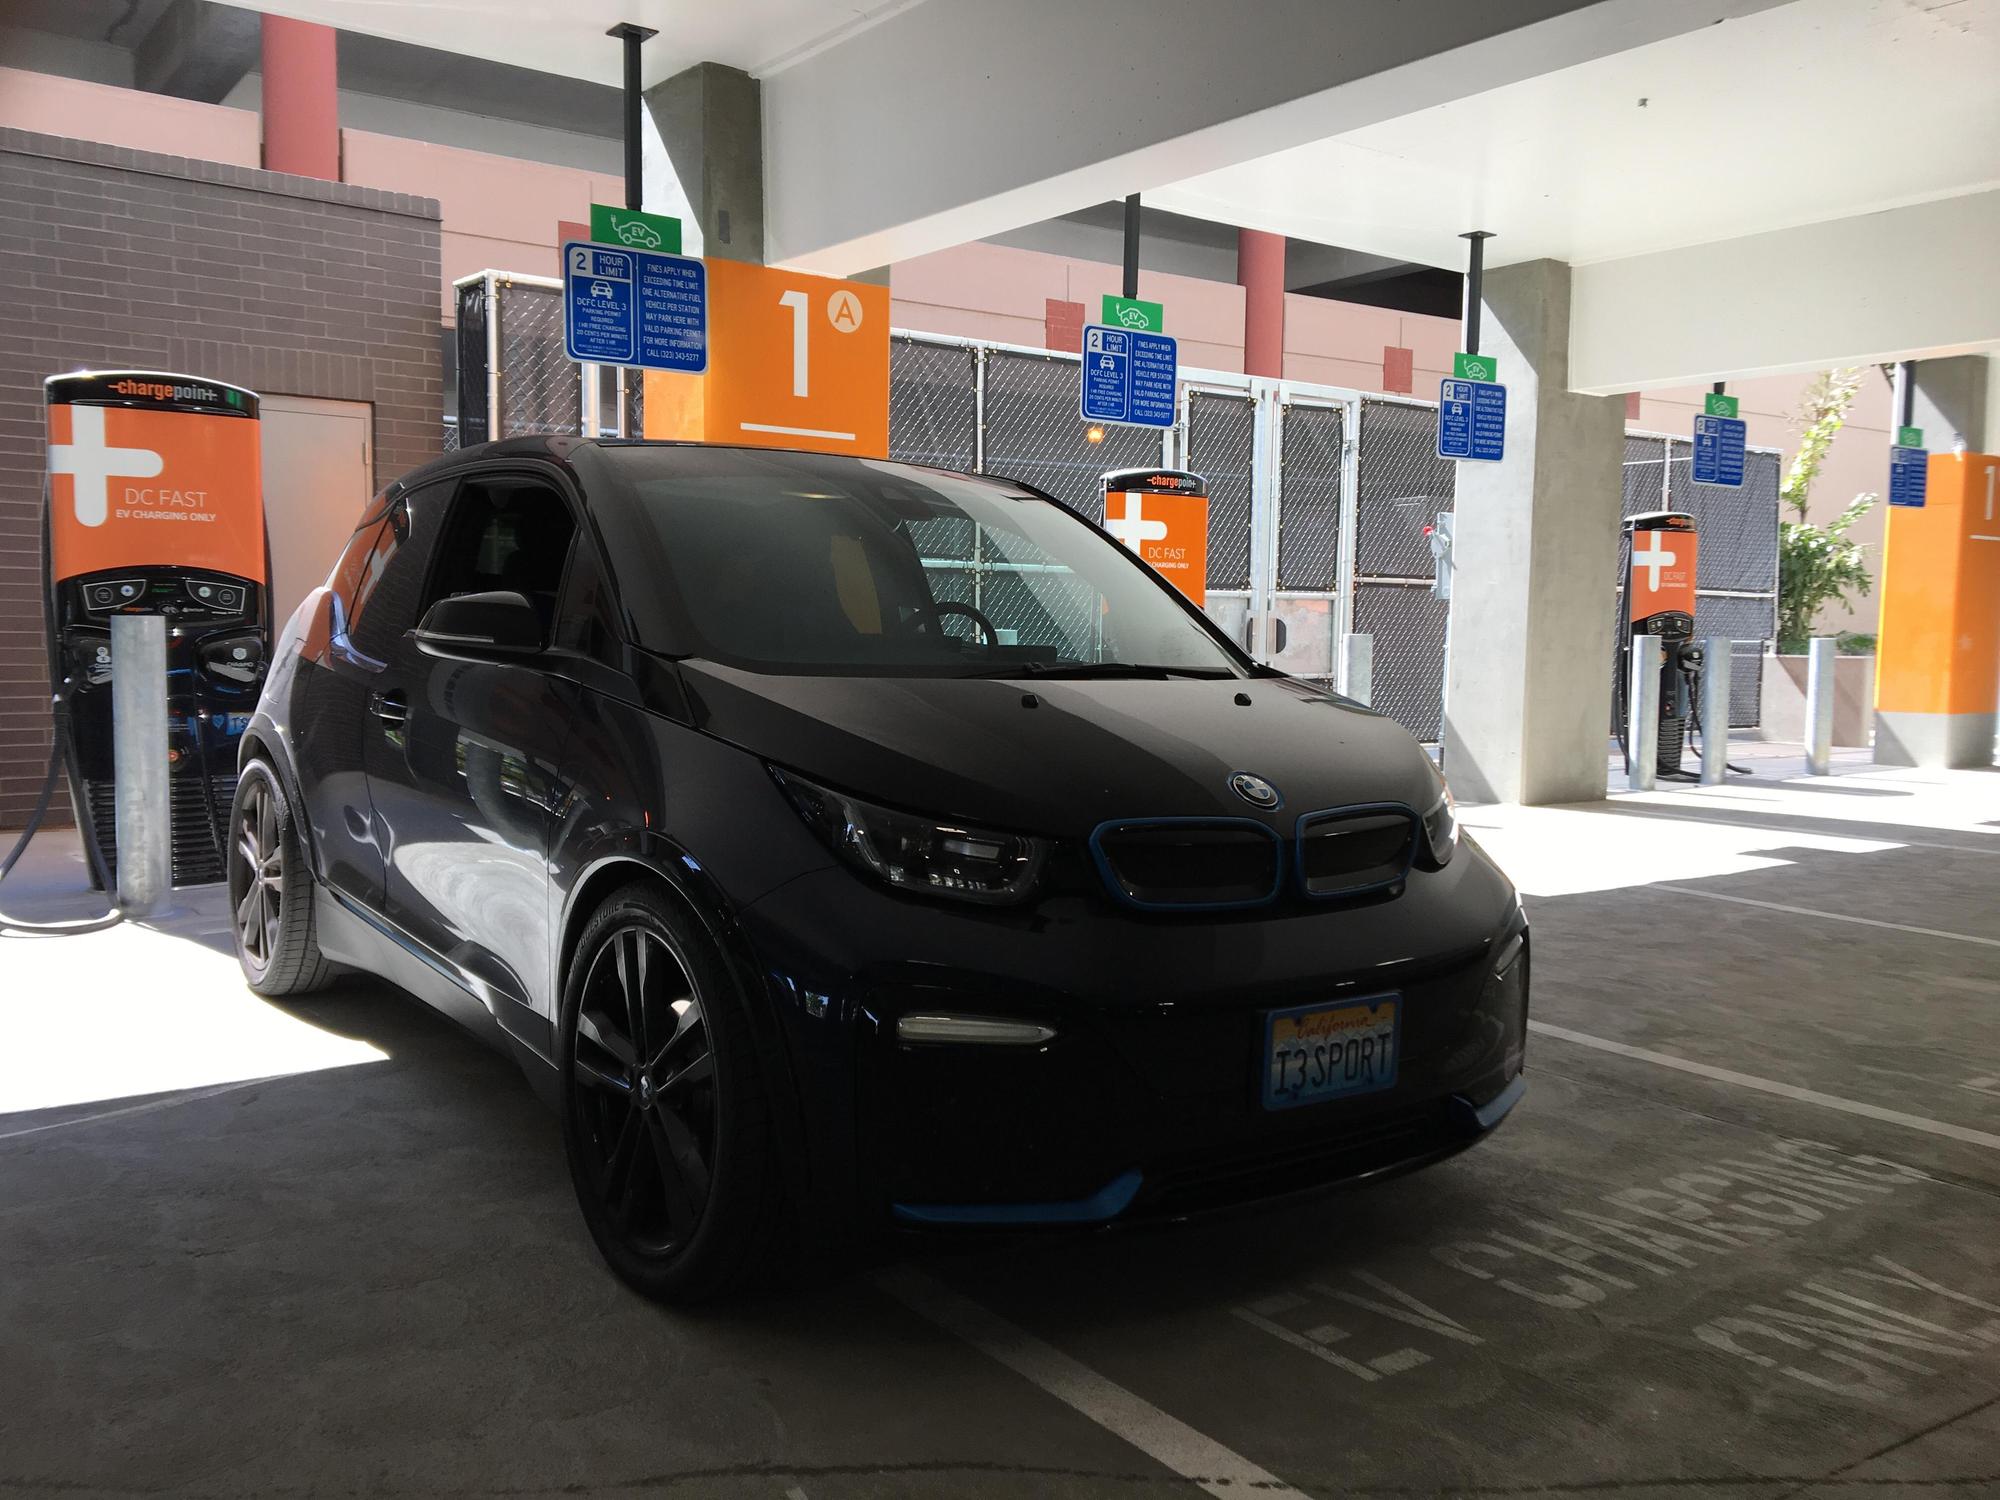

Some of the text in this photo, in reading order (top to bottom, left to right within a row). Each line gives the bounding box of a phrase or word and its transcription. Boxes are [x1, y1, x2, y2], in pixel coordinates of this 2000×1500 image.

[631, 226, 645, 237] EV
[576, 252, 586, 270] 2
[599, 255, 624, 267] HOUR
[599, 266, 624, 278] LIMIT
[647, 264, 697, 278] FINES APPLY WHEN
[644, 275, 671, 287] EXCEEDING
[673, 279, 685, 289] TIME
[642, 287, 702, 303] ONE ALTERNATIVE FUEL
[577, 297, 627, 311] DCFC LEVEL 3
[645, 300, 700, 314] VEHICLE PER STATION
[834, 296, 856, 326] A
[645, 312, 700, 326] MAY PARK HERE WITH
[1129, 311, 1139, 320] EV
[644, 324, 660, 334] VALID
[660, 325, 683, 336] PARKING
[643, 335, 702, 350] FOR MORE INFORMATION
[779, 290, 808, 397] 1
[1091, 333, 1099, 348] 2
[1106, 334, 1122, 344] HOUR
[647, 348, 660, 358] CALL
[1106, 343, 1122, 353] LIMIT
[1446, 385, 1451, 397] 2
[125, 488, 208, 508] DC FAST
[116, 509, 216, 522] EV CHARGING ONLY
[1148, 547, 1187, 559] DC FAST
[1297, 1014, 1374, 1041] California
[1274, 1033, 1391, 1095] I3SPORT
[1430, 1137, 1930, 1309] CHARGING
[1229, 1269, 1486, 1382] EV
